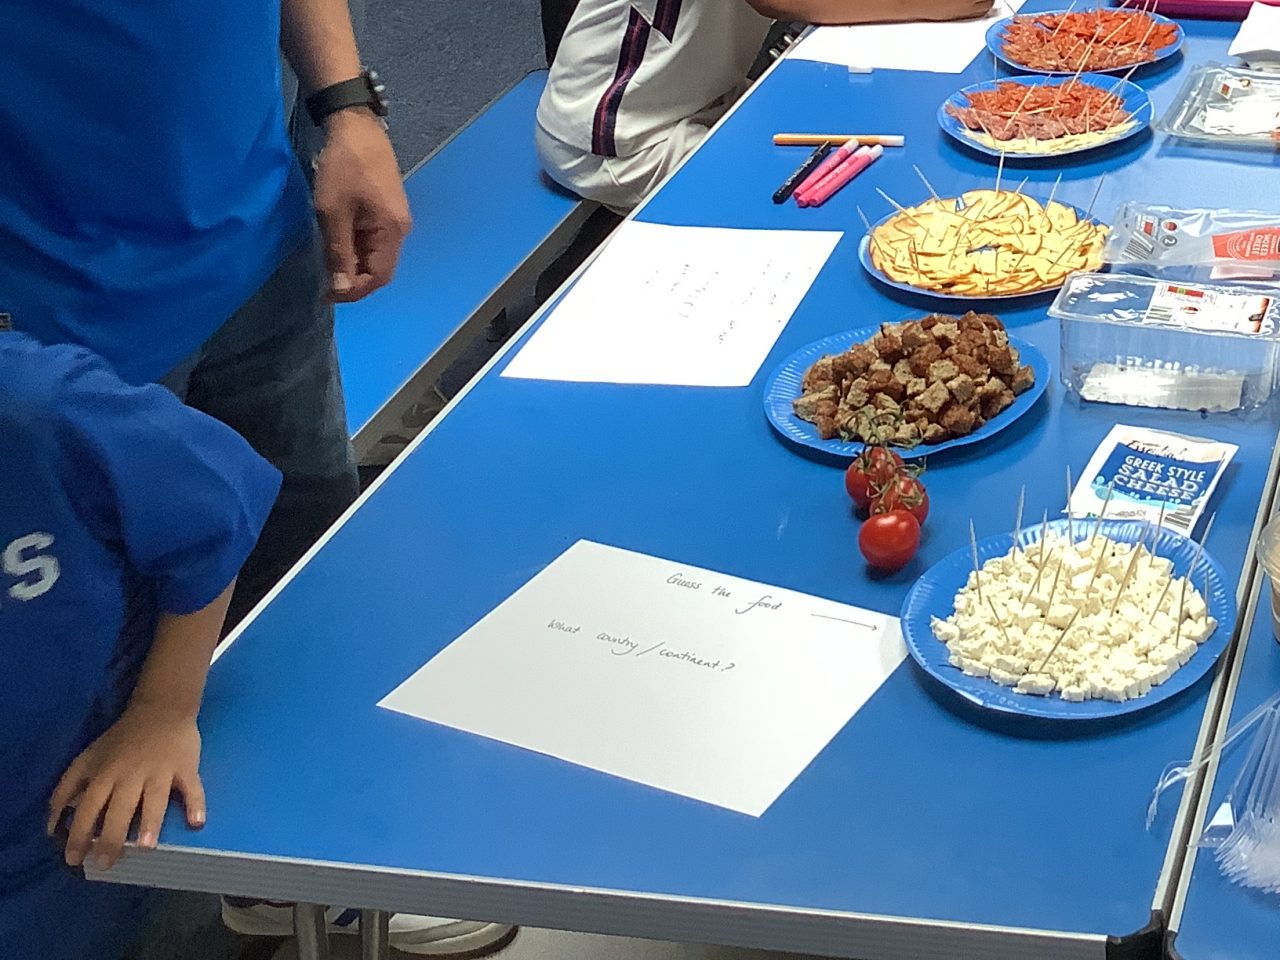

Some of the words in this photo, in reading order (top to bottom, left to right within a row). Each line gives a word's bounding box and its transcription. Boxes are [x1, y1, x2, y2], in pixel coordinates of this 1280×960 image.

[1118, 464, 1199, 492] SALAD
[1125, 455, 1165, 473] GREEK
[1167, 466, 1206, 482] STYLE
[1114, 474, 1195, 500] CHEESE
[666, 572, 702, 593] Guess
[712, 585, 732, 598] the
[734, 594, 782, 615] food
[547, 619, 581, 635] What
